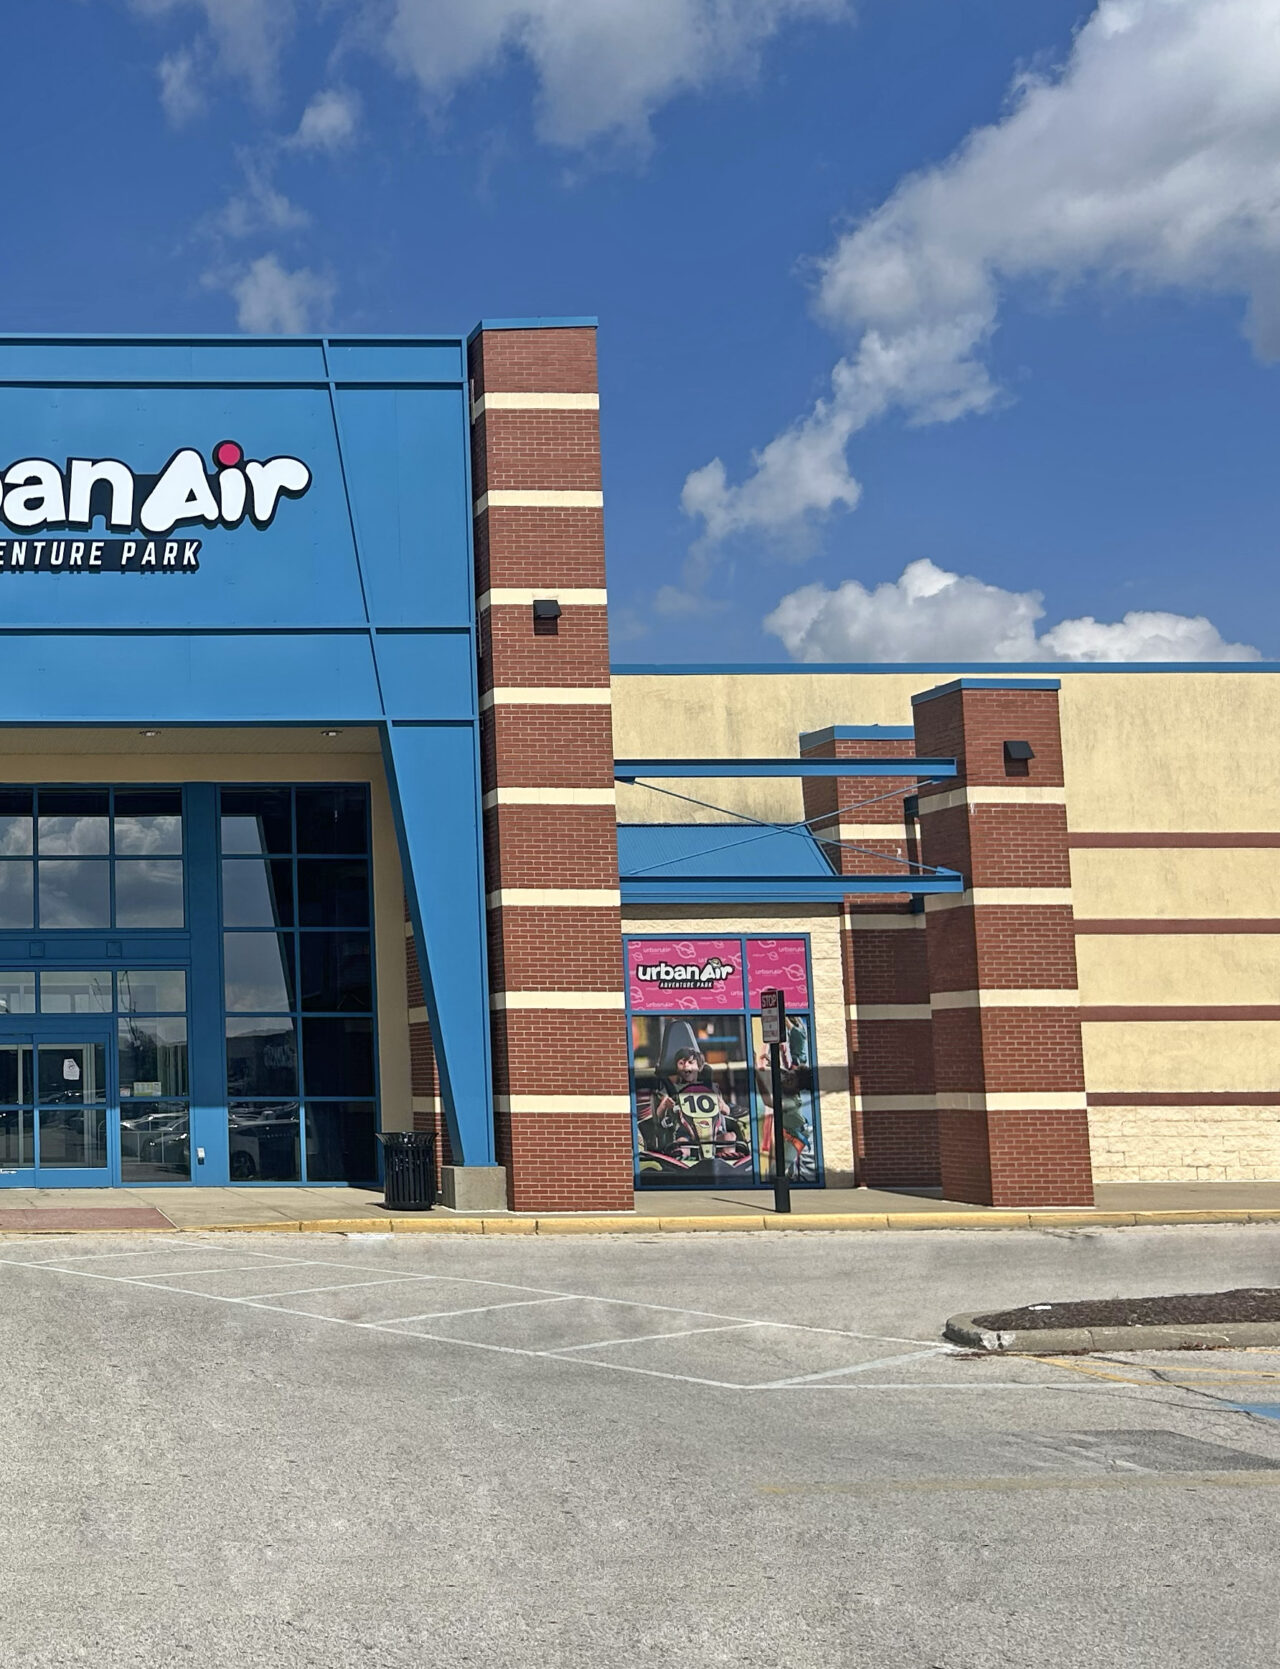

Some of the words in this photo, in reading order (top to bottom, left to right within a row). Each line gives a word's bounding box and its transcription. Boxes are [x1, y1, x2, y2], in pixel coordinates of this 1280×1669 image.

[120, 541, 200, 566] PARK
[696, 981, 713, 989] PARK
[762, 993, 778, 1007] STOP
[683, 1094, 716, 1114] 10
